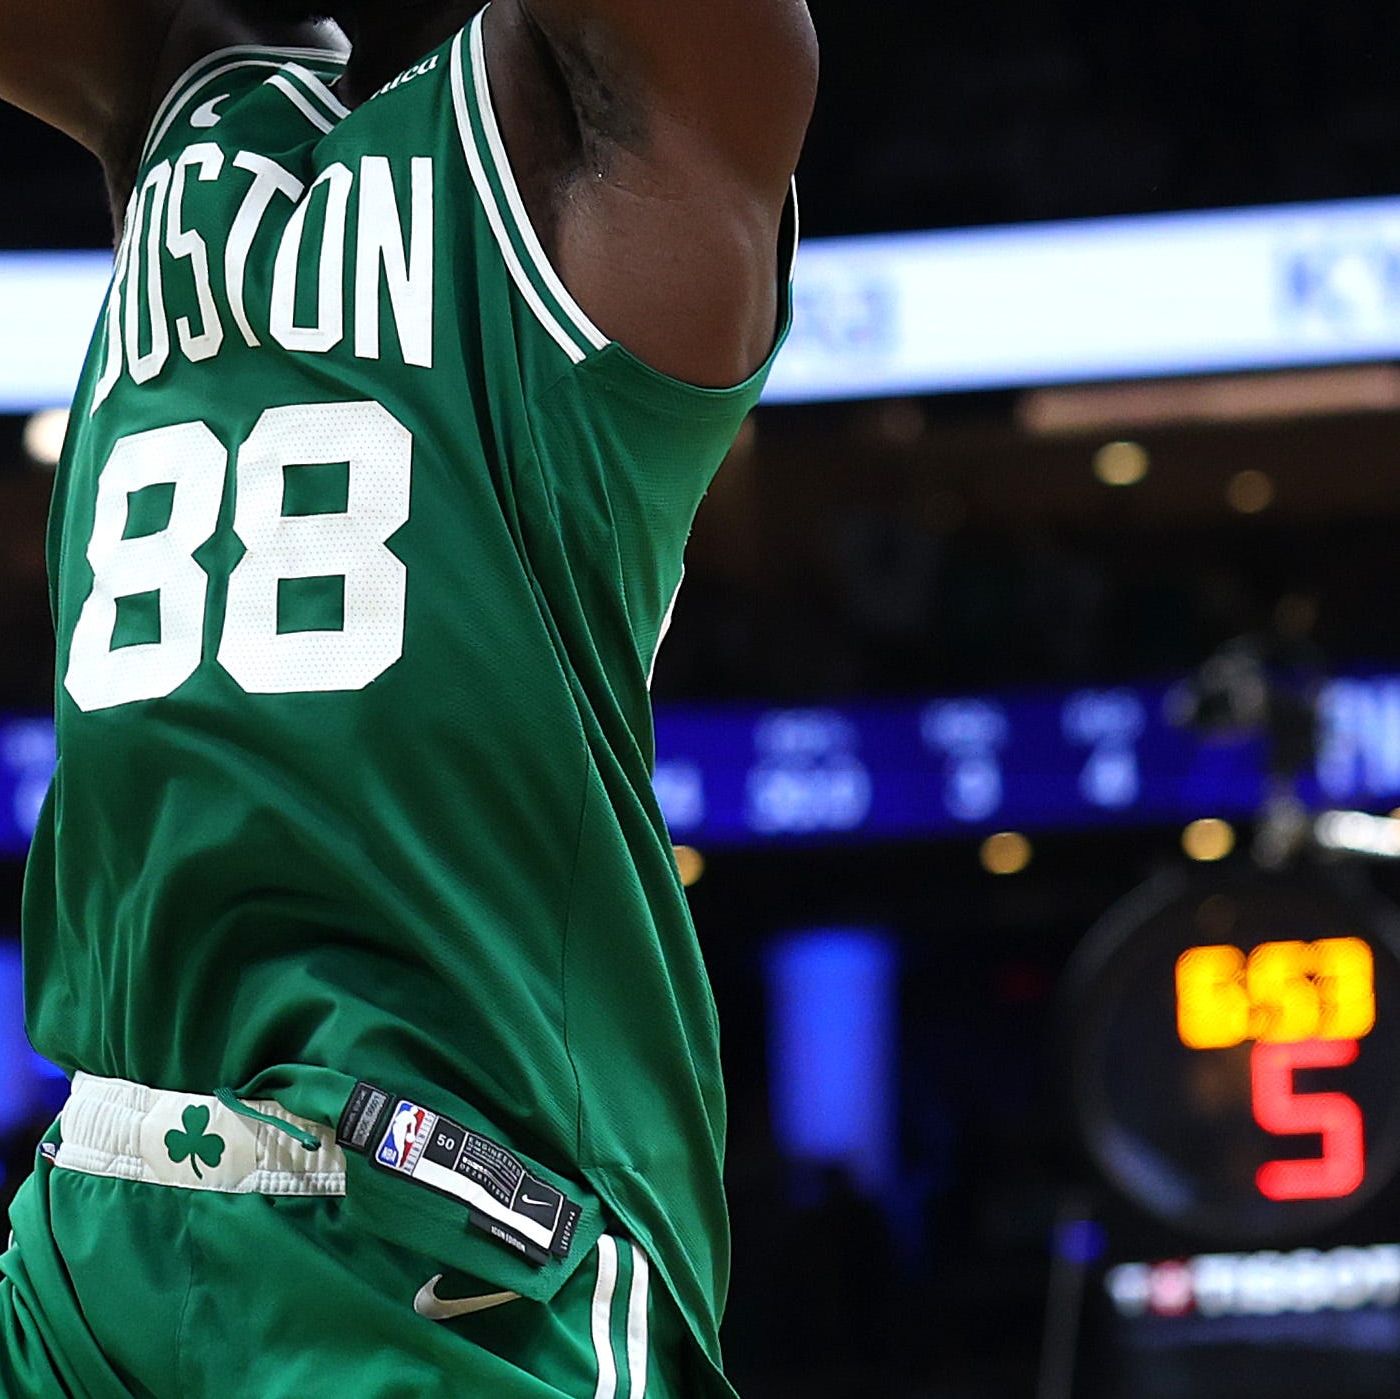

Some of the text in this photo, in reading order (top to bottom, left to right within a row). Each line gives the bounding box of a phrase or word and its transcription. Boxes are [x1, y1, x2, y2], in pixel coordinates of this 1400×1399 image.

[64, 401, 413, 712] 88
[436, 1133, 455, 1151] 50
[1251, 1038, 1365, 1200] 5
